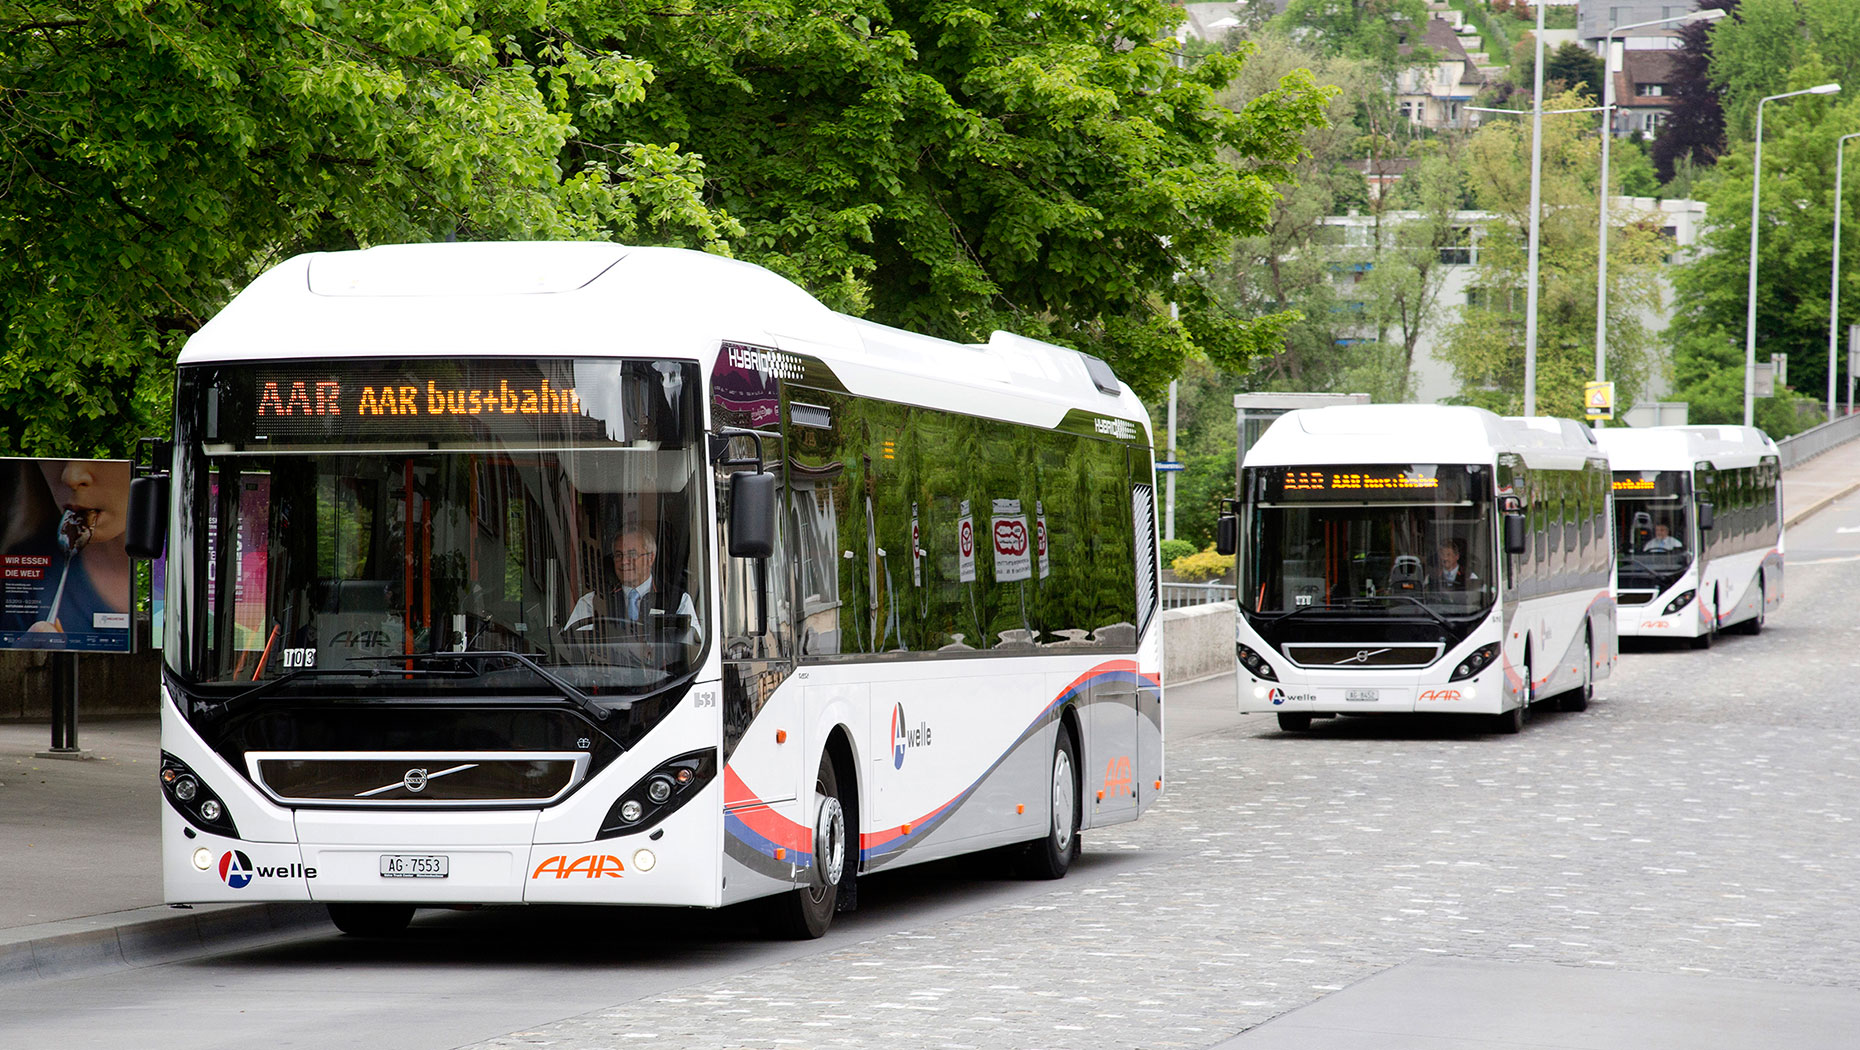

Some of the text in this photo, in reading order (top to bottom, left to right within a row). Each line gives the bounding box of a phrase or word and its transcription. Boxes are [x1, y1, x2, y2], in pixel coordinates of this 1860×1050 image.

[728, 347, 769, 373] HYBRID
[258, 379, 581, 415] AAR AAR bus+bahn
[21, 557, 49, 565] ESSEN
[5, 569, 41, 578] DIE WELT
[328, 630, 392, 648] AAR
[1287, 693, 1317, 702] welle
[1418, 690, 1462, 701] AAR
[907, 721, 932, 748] welle
[1104, 755, 1132, 799] AAR
[256, 863, 318, 879] welle
[532, 854, 625, 879] AAR
